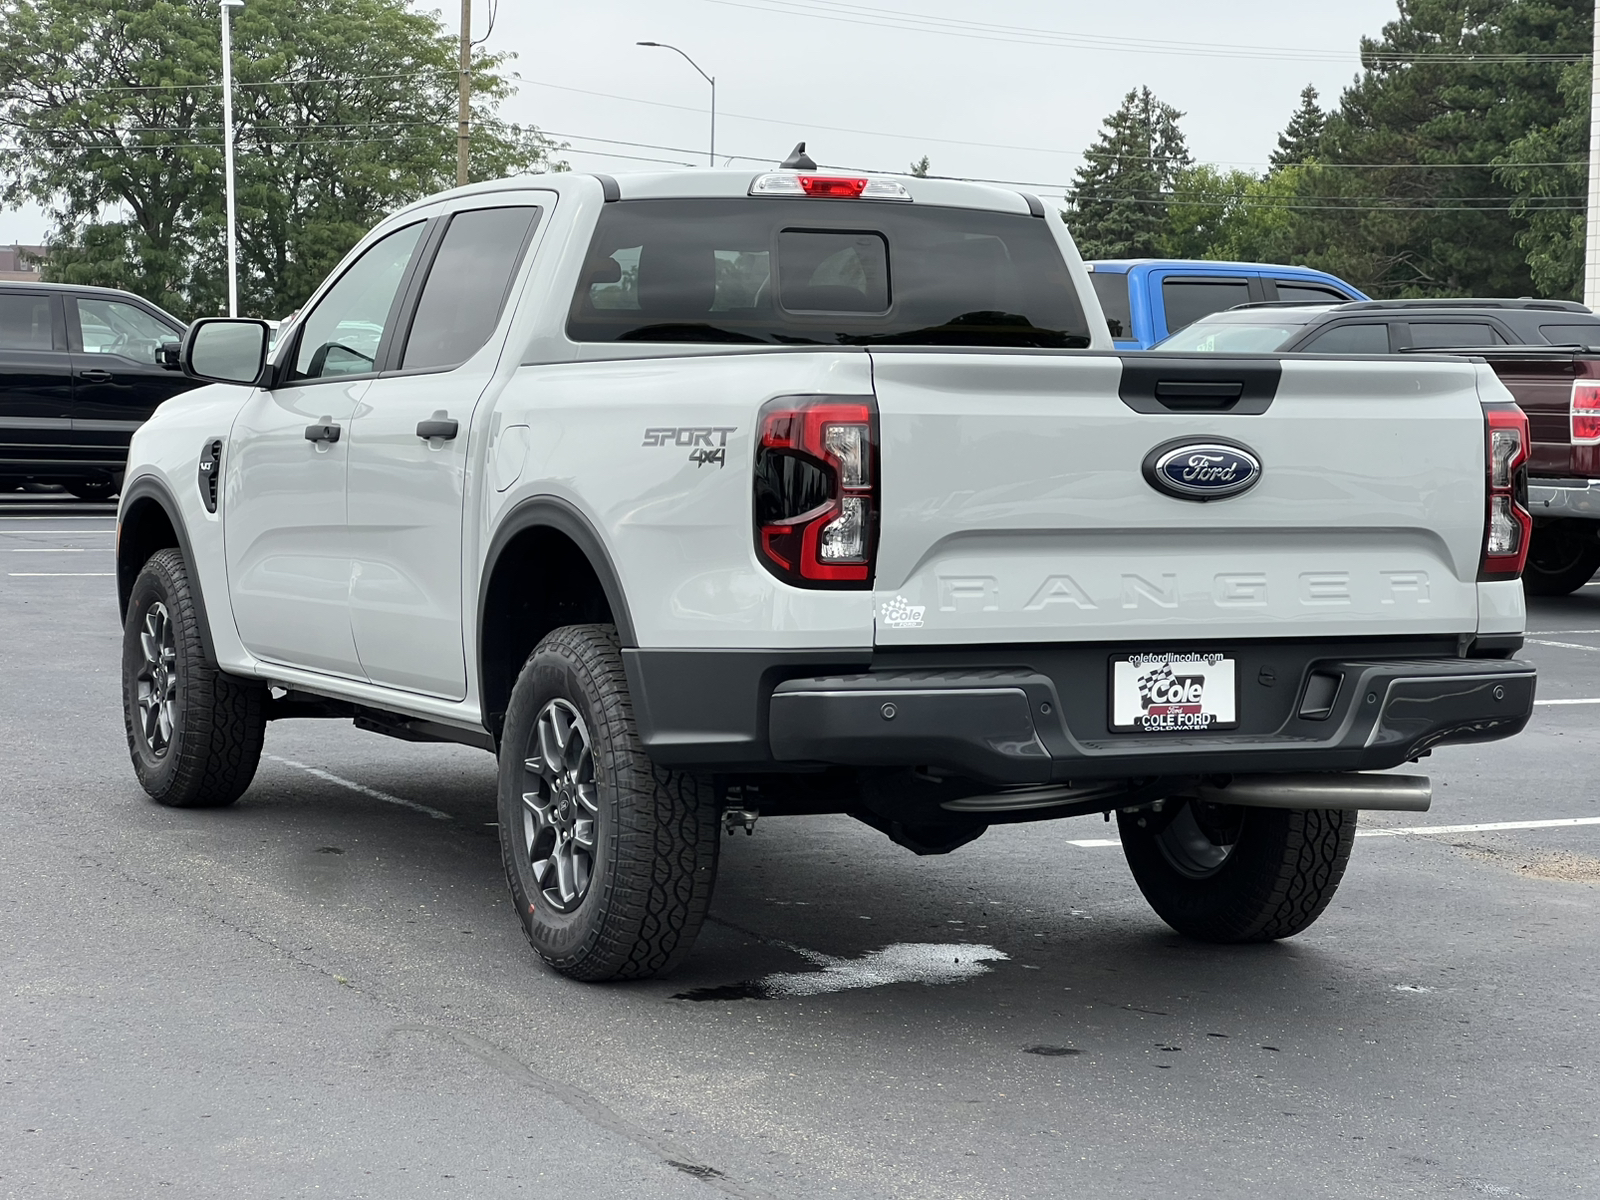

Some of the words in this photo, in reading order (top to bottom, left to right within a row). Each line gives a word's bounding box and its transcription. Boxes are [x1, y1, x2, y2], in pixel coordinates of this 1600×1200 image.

[641, 426, 738, 447] SPORT
[688, 448, 726, 470] 4x4
[1182, 454, 1238, 482] Ford
[937, 569, 1432, 613] RANGER
[888, 609, 921, 621] Cole
[1128, 652, 1224, 664] colefordlincoln.com
[1151, 678, 1203, 704] Cole
[1141, 714, 1175, 727] COLE
[1177, 713, 1211, 726] FORD
[1166, 706, 1184, 714] Ford
